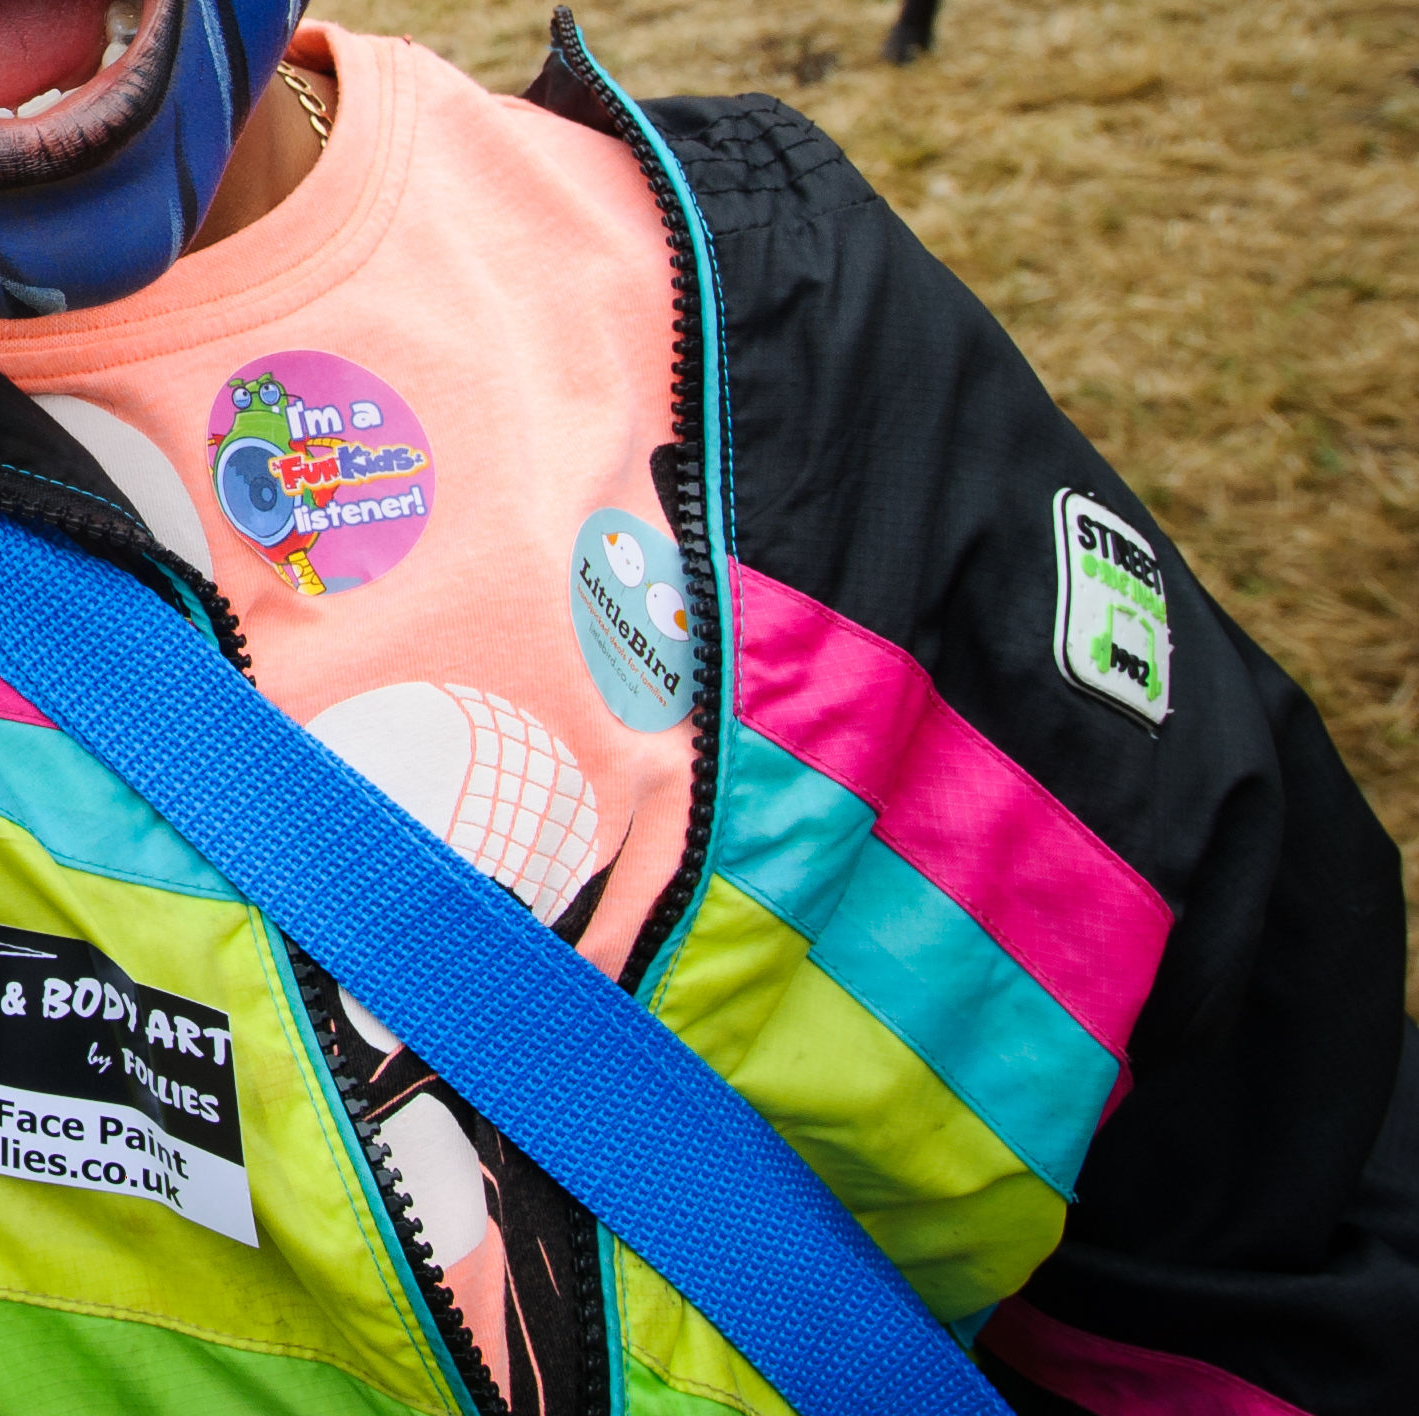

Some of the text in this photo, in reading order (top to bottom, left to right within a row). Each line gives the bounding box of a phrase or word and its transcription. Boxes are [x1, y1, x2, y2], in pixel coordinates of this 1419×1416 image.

[286, 400, 383, 441] I'm a
[293, 486, 426, 534] listener!
[1077, 514, 1162, 595] STREET
[579, 557, 681, 696] LittleBird
[627, 657, 639, 673] for
[0, 981, 27, 1016] &
[42, 977, 138, 1033] BODY
[145, 1008, 232, 1066] ART
[87, 1041, 220, 1123] by FOLLIES
[99, 1115, 189, 1180] Paint
